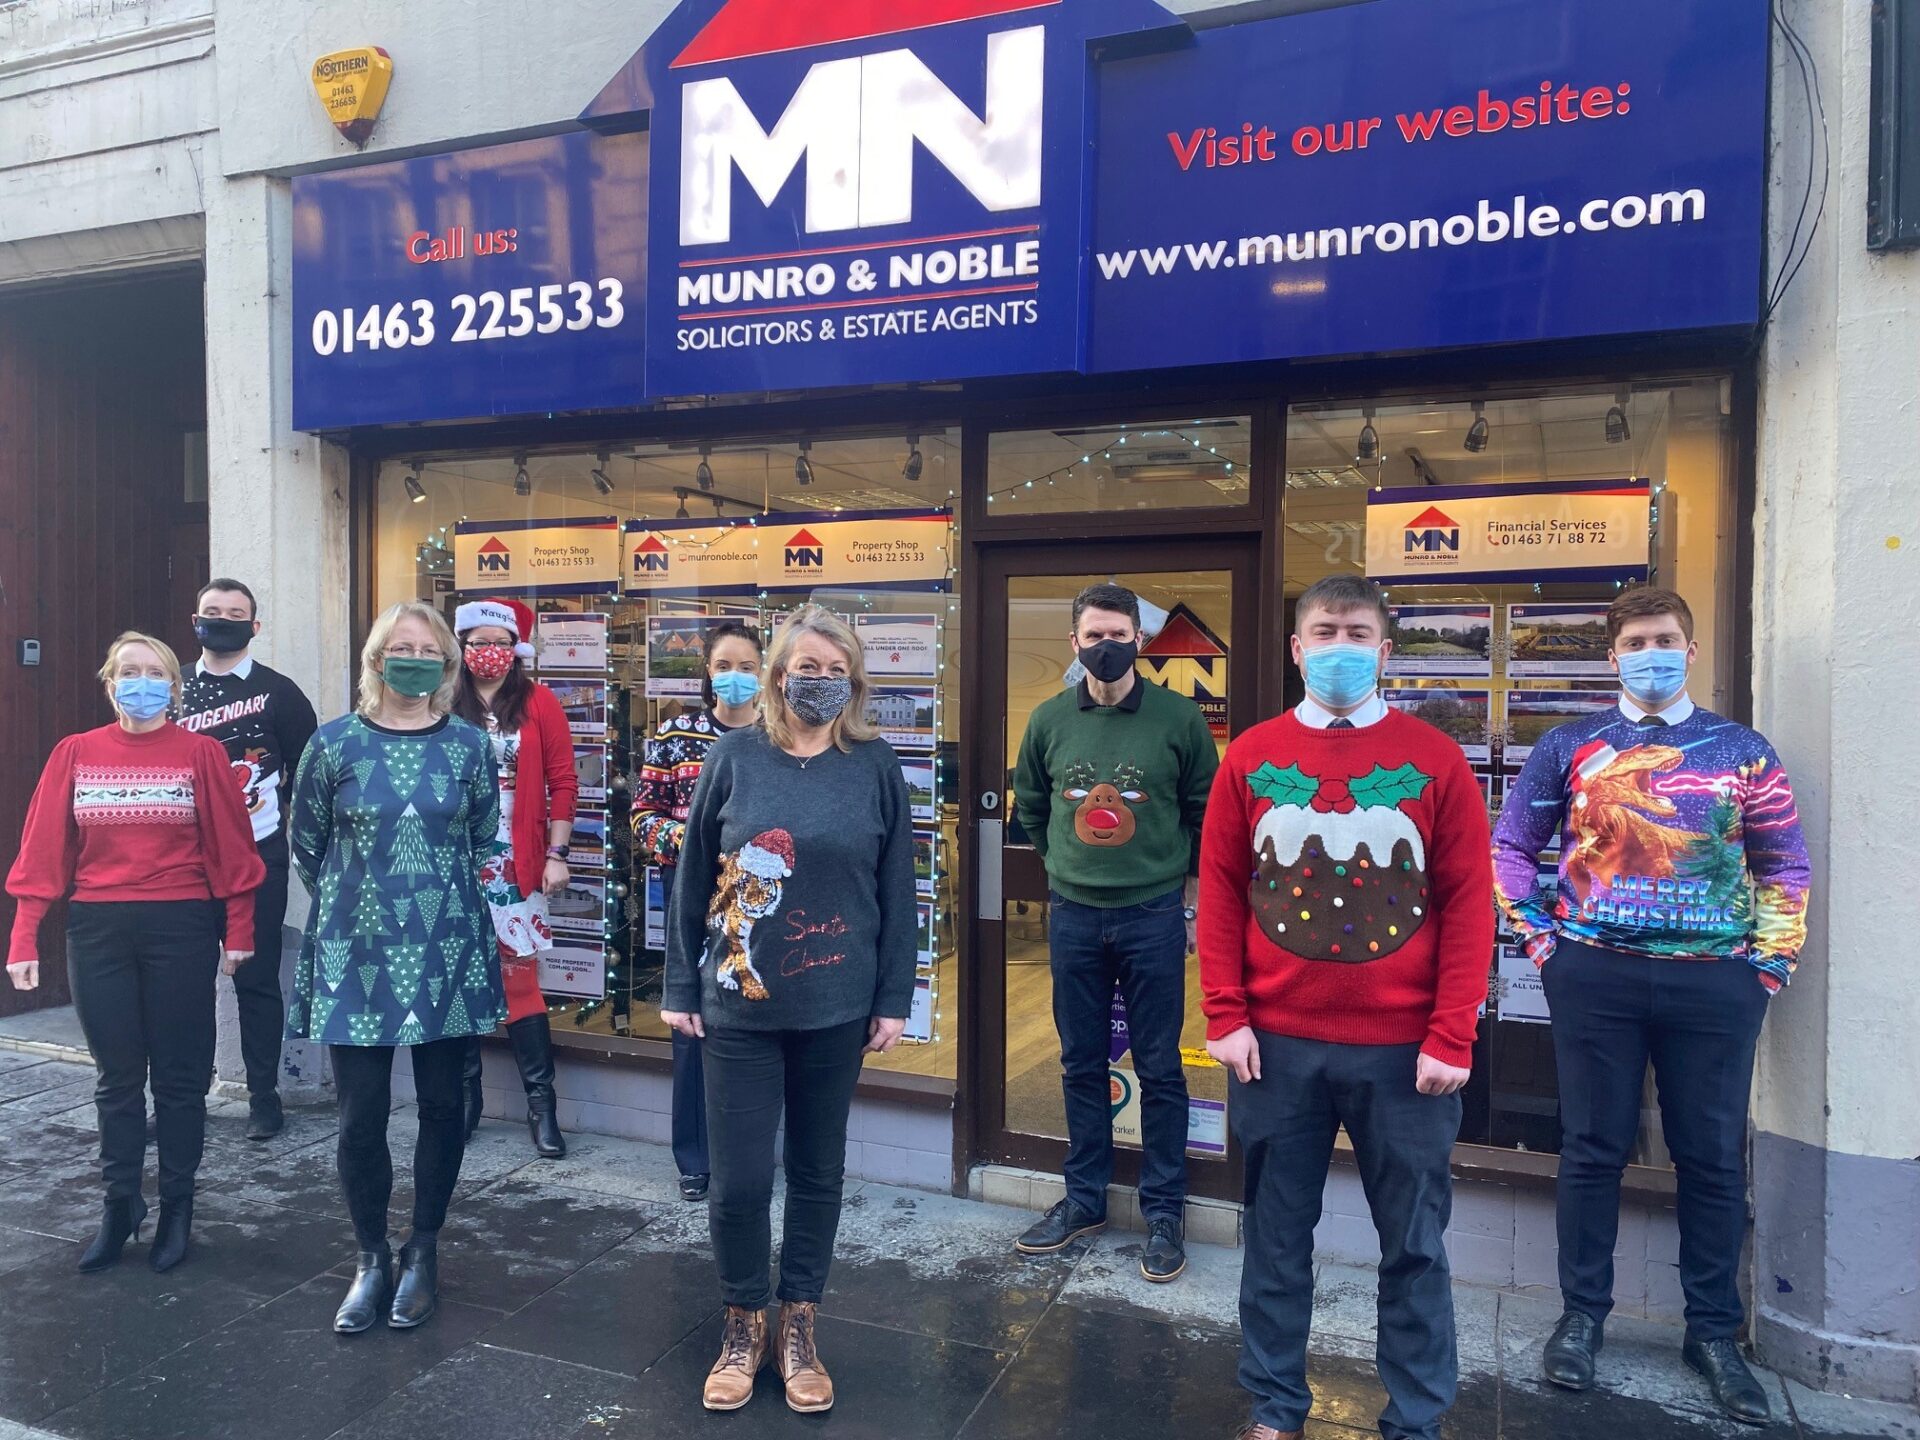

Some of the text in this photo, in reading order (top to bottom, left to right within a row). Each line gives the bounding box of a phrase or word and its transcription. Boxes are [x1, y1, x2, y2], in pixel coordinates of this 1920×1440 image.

[316, 56, 368, 77] NORTHERN
[332, 84, 354, 97] 01463
[1167, 80, 1632, 171] Visit our website:
[679, 25, 1045, 246] MN
[1095, 186, 1706, 280] www.munronoble.com
[405, 225, 518, 264] Call us:
[677, 240, 1040, 307] MUNRO & NOBLE
[311, 277, 625, 356] 01463 225533
[677, 300, 1038, 351] SOLICITORS & ESTATE AGENTS
[1487, 519, 1607, 532] Financial Services
[852, 540, 919, 551] Property Shop
[1404, 529, 1459, 552] MN
[1501, 531, 1606, 546] 01463 71 88 72
[534, 546, 590, 557] Property Shop
[785, 547, 823, 566] MN
[855, 552, 925, 563] 01463 22 55 33
[477, 553, 510, 571] MN
[536, 557, 595, 567] 01463 22 55 33
[633, 553, 669, 571] MN
[1199, 703, 1227, 713] OBLE
[1611, 873, 1713, 905] MERRY
[1582, 896, 1736, 931] CHRISTMAS
[1512, 982, 1528, 990] ALL
[1112, 1124, 1136, 1135] arket
